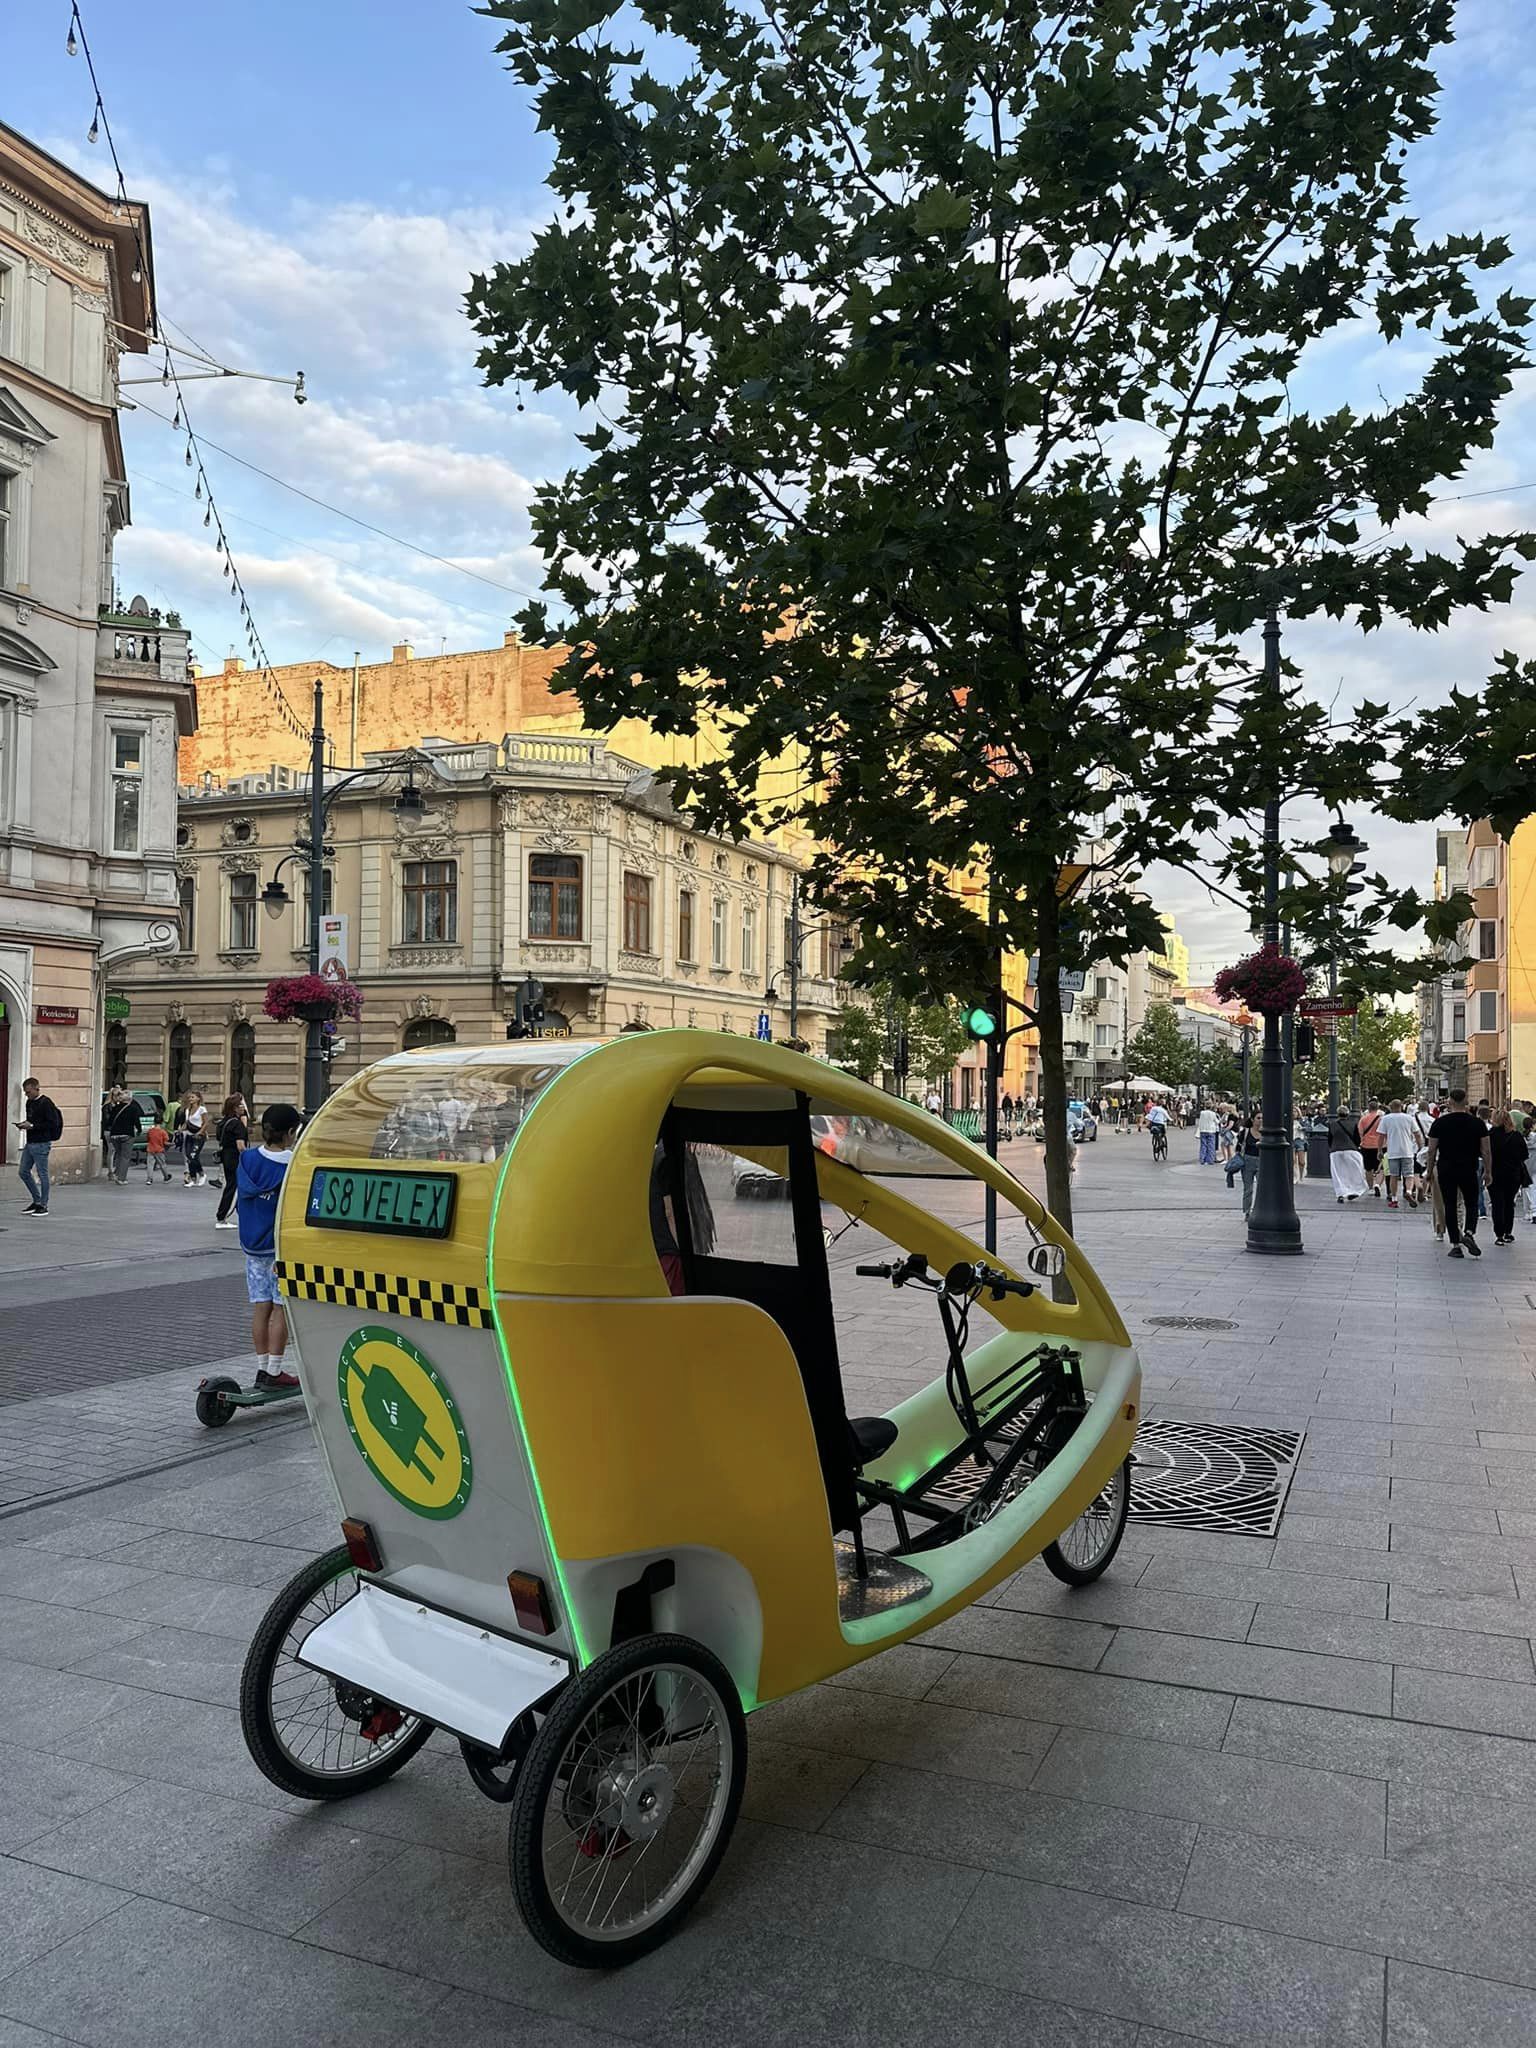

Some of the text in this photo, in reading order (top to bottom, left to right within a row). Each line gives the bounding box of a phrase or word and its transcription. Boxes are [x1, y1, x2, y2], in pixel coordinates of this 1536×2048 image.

[105, 1001, 128, 1012] abka
[311, 1198, 320, 1210] PL
[326, 1176, 445, 1228] S8 VELEX
[339, 1330, 471, 1505] VEHICLE ELECTRIC
